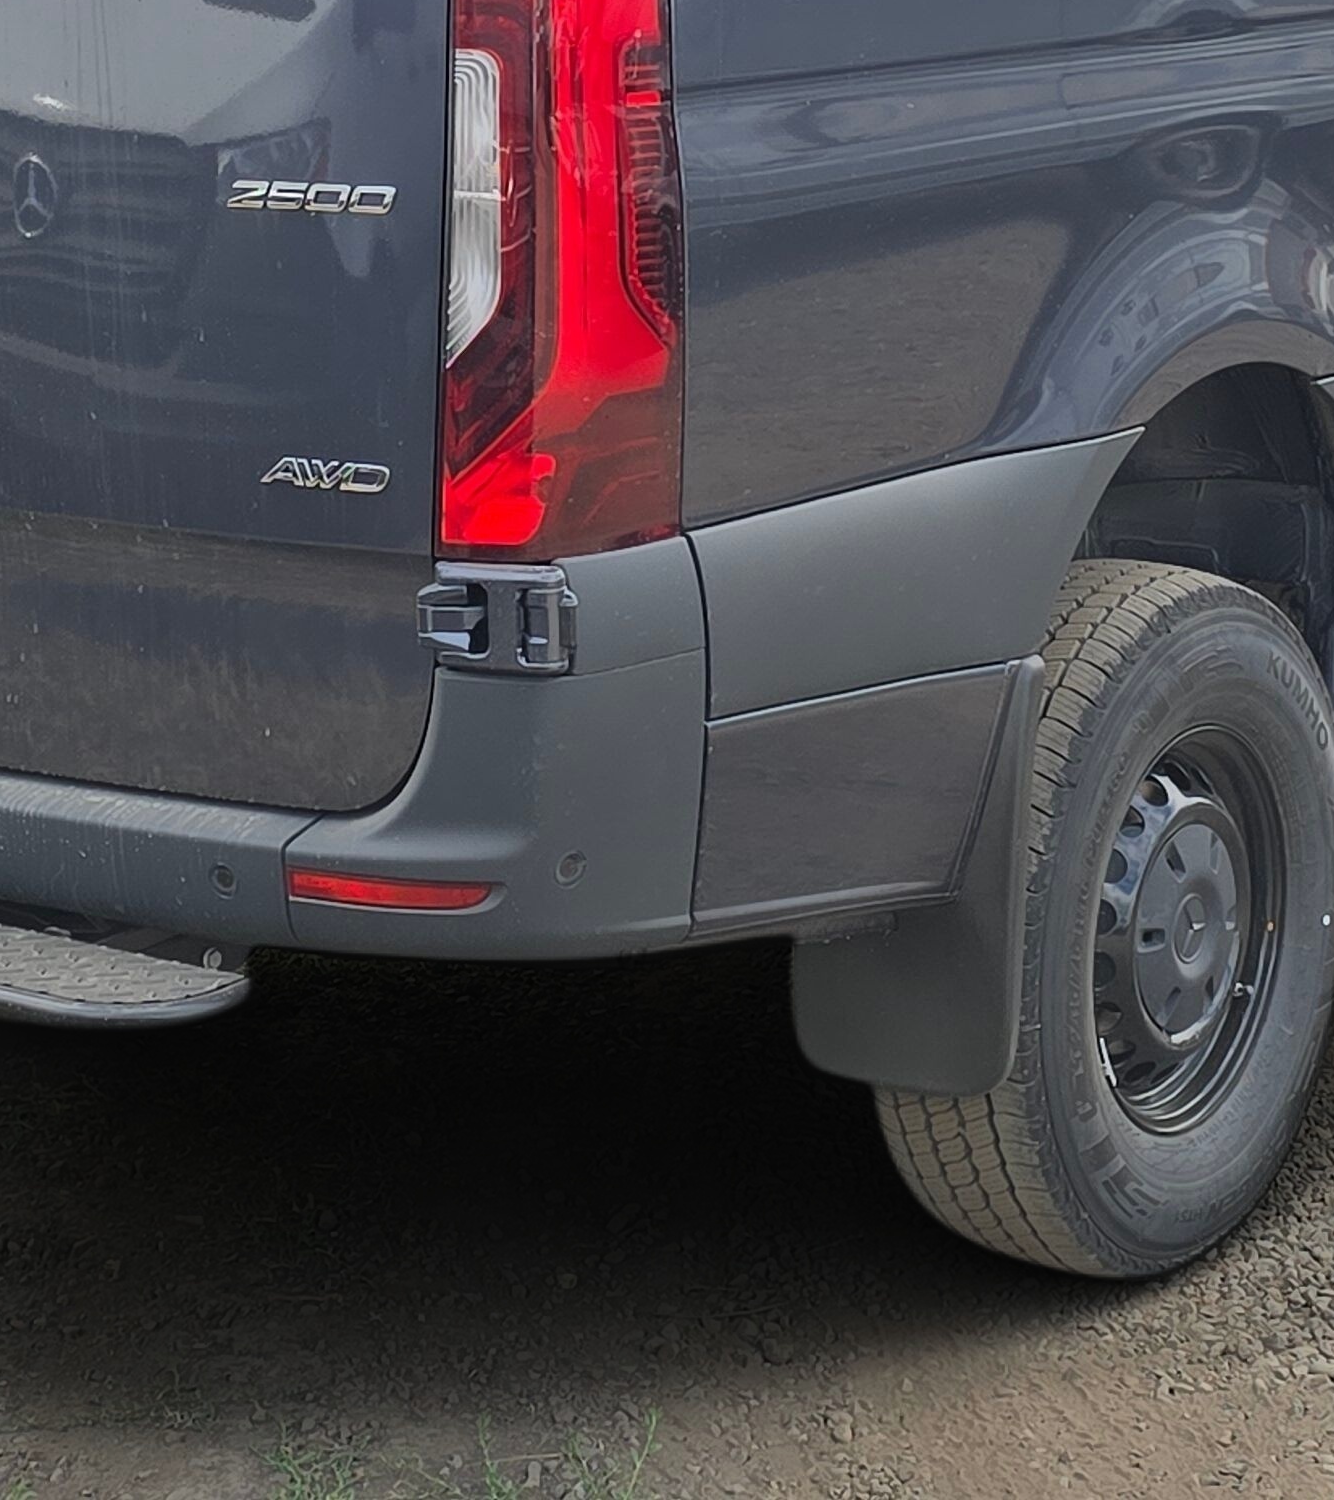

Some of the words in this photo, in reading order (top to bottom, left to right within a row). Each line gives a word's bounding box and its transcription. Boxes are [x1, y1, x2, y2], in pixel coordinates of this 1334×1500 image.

[227, 180, 397, 215] 2500
[260, 457, 390, 493] AWD
[1267, 650, 1328, 750] KUMHO
